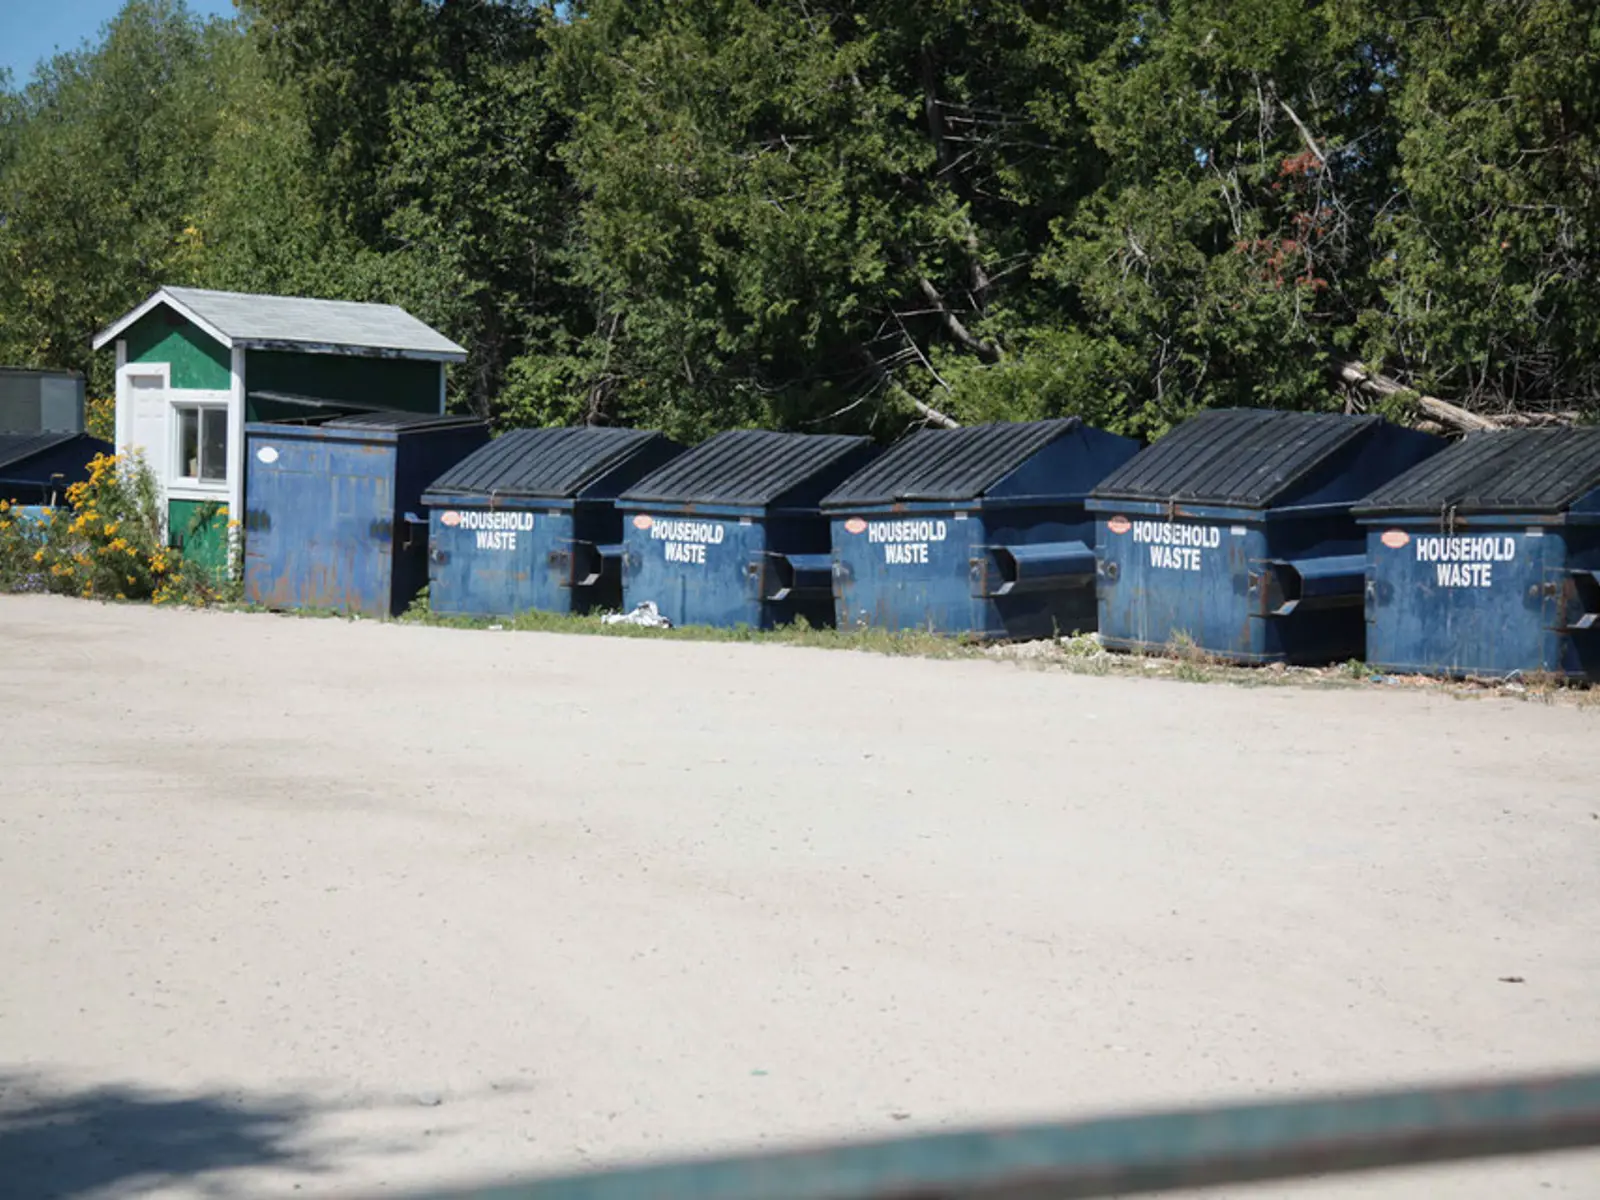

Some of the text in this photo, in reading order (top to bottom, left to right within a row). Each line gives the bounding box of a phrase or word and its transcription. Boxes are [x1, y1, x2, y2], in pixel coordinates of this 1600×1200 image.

[460, 511, 534, 531] HOUSEHOLD
[651, 520, 724, 544] HOUSEHOLD
[868, 520, 947, 543] HOUSEHOLD
[476, 531, 516, 551] WASTE
[1133, 521, 1220, 548] HOUSEHOLD
[664, 544, 706, 563] WASTE
[884, 543, 929, 564] WASTE
[1150, 545, 1201, 571] WASTE
[1416, 537, 1515, 561] HOUSEHOLD
[1437, 563, 1492, 587] WASTE
